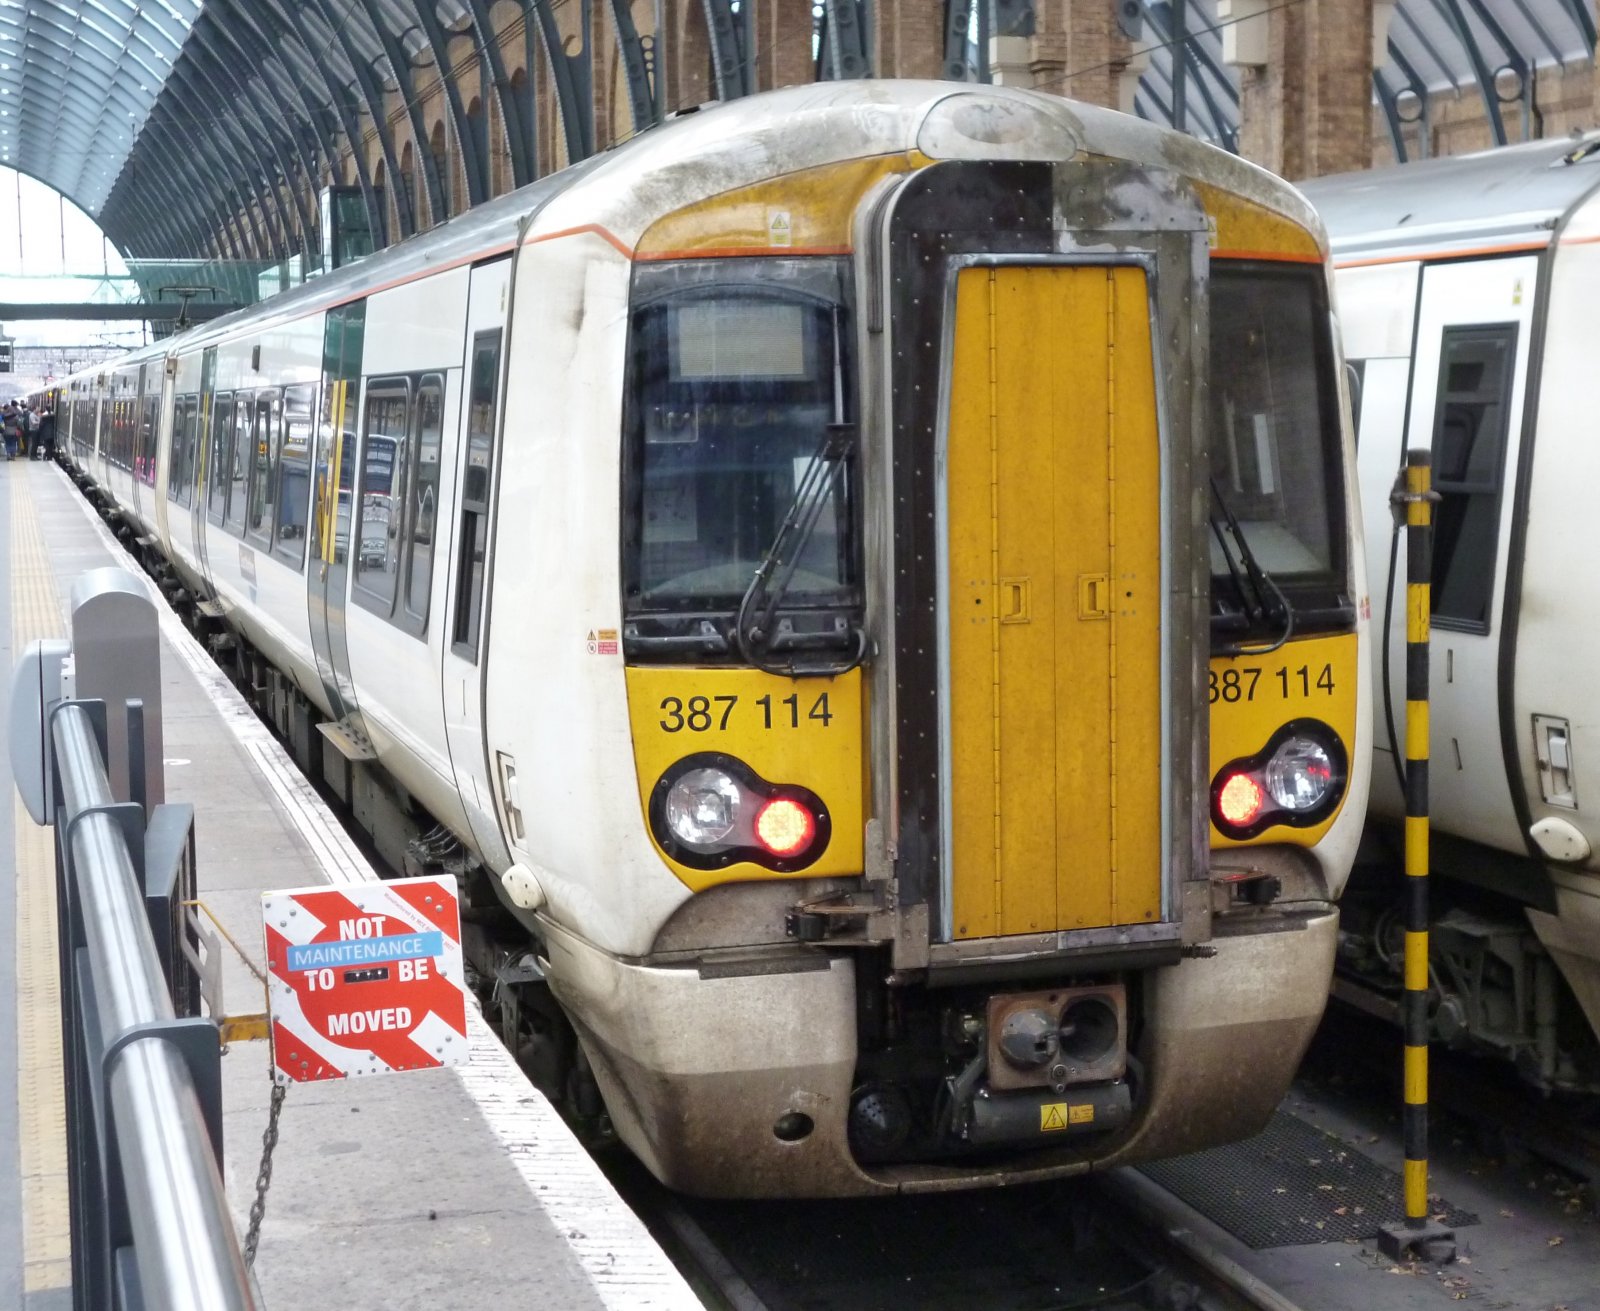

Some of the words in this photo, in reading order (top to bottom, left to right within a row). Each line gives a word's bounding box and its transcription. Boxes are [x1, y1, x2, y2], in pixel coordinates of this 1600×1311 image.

[1275, 663, 1335, 699] 114
[659, 695, 738, 733] 387
[755, 692, 833, 729] 114
[339, 916, 386, 941] NOT
[294, 938, 423, 966] MAINTENANCE
[304, 968, 335, 992] TO
[398, 958, 429, 983] BE
[327, 1007, 412, 1036] MOVED
